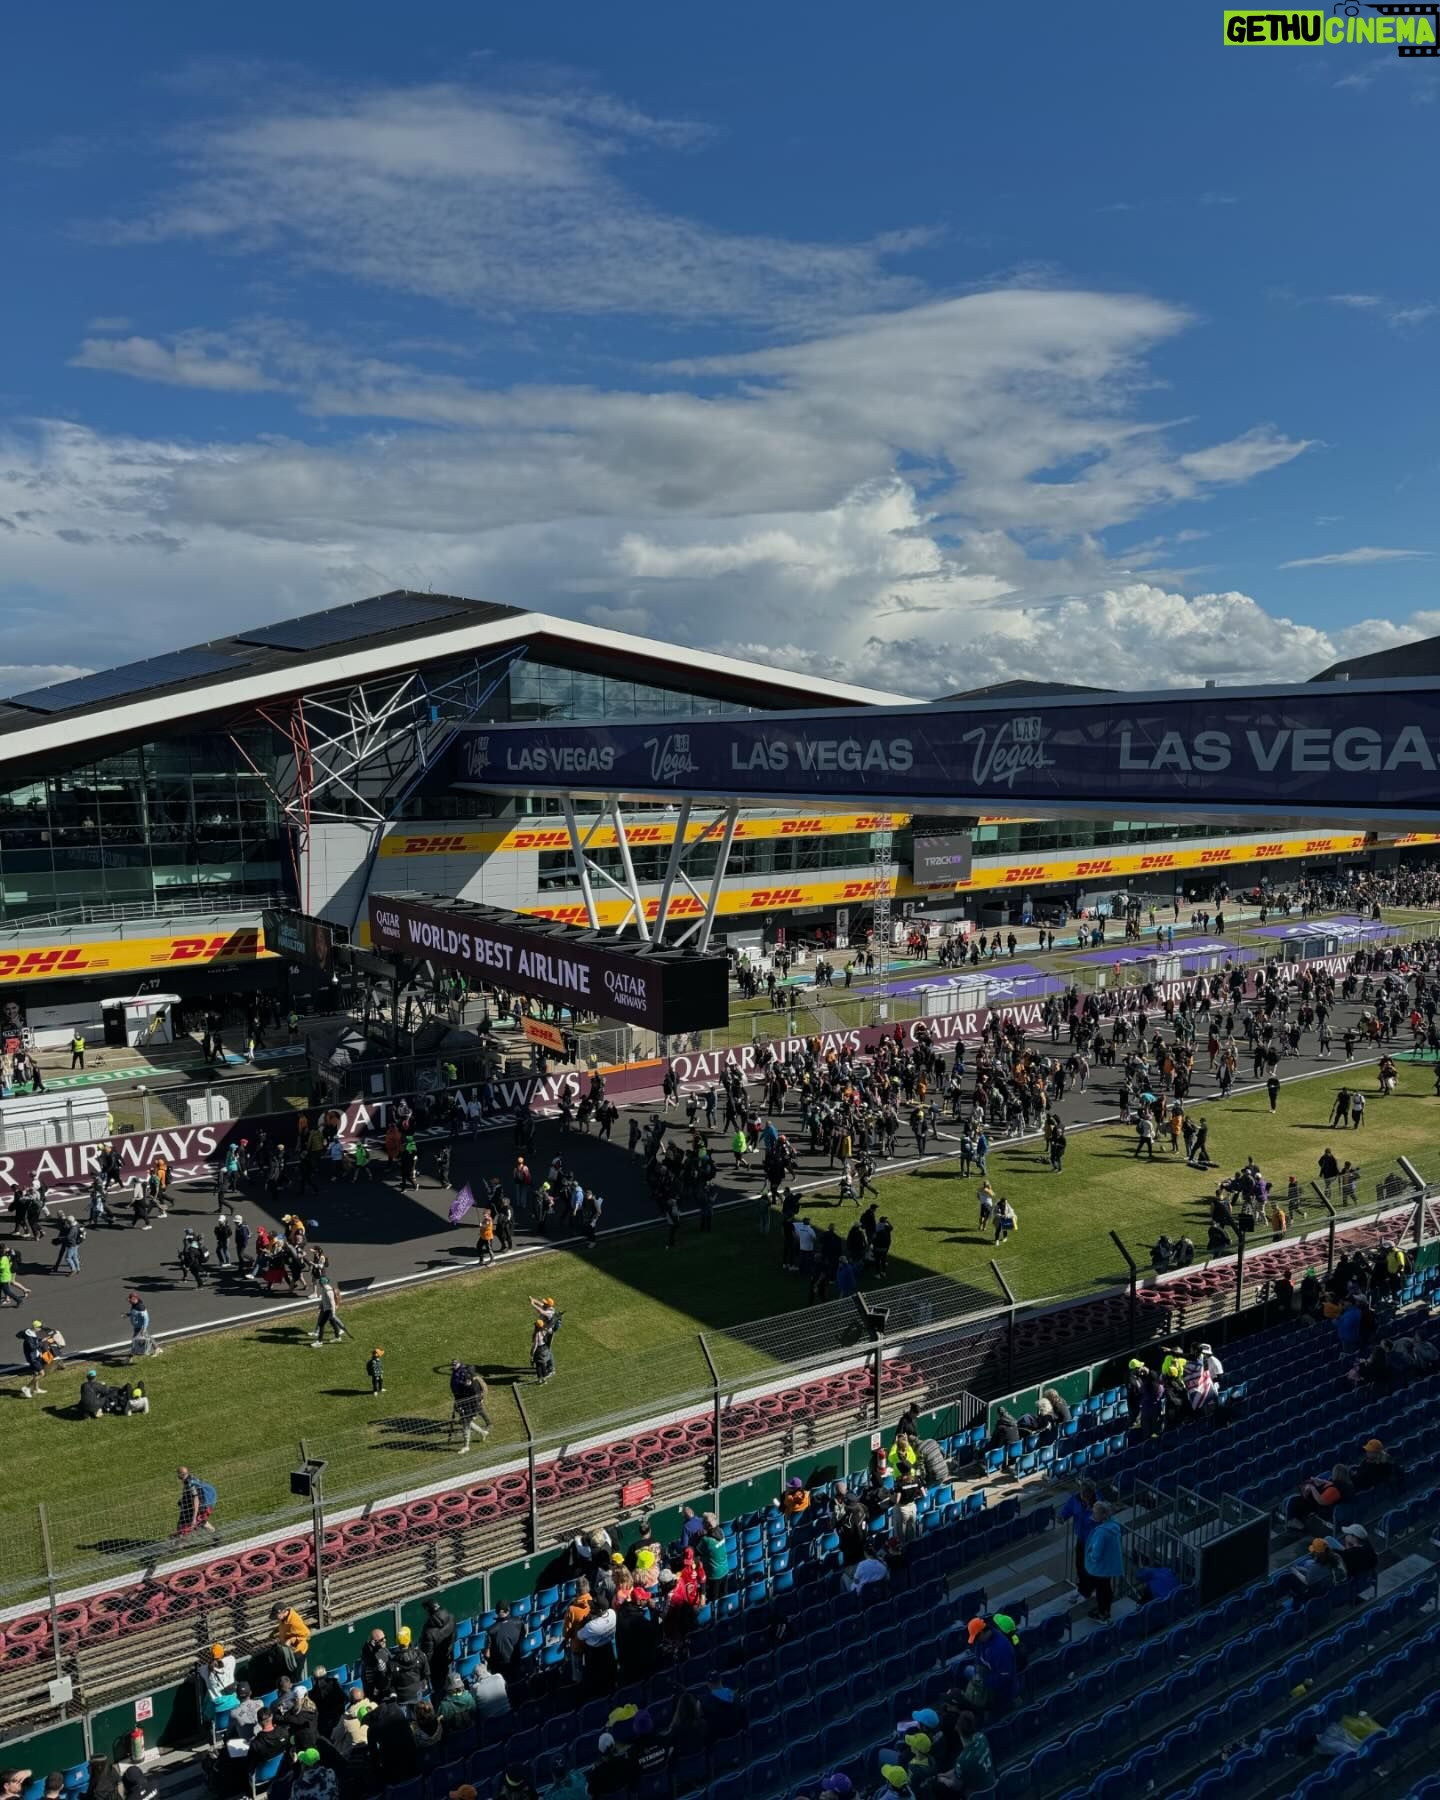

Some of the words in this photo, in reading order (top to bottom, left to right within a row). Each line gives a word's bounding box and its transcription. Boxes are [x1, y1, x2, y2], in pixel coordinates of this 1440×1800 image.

[1012, 716, 1042, 742] LAS
[731, 741, 789, 770] LAS
[795, 738, 914, 771] VEGAS
[963, 721, 1055, 789] Vegas
[1119, 730, 1232, 772] LAS
[1246, 725, 1440, 772] VEGA
[507, 748, 547, 771] LAS
[550, 747, 615, 771] VEGAS
[644, 736, 699, 784] Vegas
[781, 820, 823, 833] DHL
[856, 816, 892, 829] DHL
[404, 837, 466, 853] DHL
[514, 832, 570, 848] DHL
[1306, 840, 1332, 852] DHL
[1200, 849, 1232, 862] DHL
[1255, 844, 1284, 857] DHL
[1076, 860, 1113, 875] DHL
[1141, 854, 1175, 869] DHL
[1005, 867, 1045, 882] DHL
[750, 888, 804, 907] DHL
[844, 880, 890, 898] DHL
[376, 909, 400, 928] QATAR
[169, 934, 266, 960] DHL
[408, 918, 471, 959] WORLD'S
[474, 936, 513, 972] BEST
[518, 953, 591, 994] AIRLINE
[604, 970, 646, 997] QATAR
[614, 993, 647, 1012] AIRWAYS
[670, 1046, 757, 1082] QATAR
